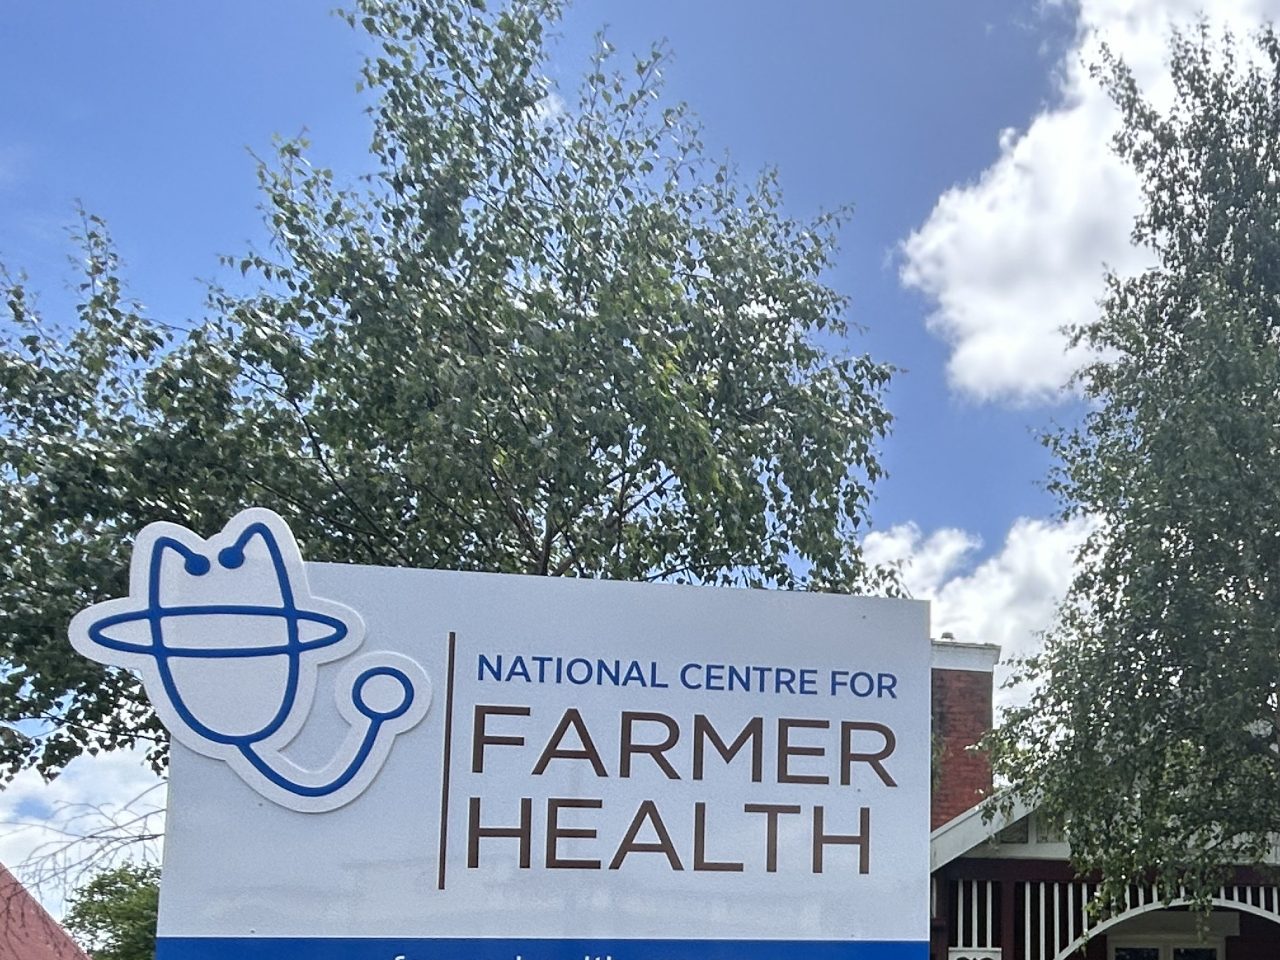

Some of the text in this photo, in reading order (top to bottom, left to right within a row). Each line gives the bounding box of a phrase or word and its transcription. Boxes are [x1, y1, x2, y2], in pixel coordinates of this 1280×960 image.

[477, 654, 898, 699] NATIONAL CENTRE FOR
[472, 704, 898, 788] FARMER
[467, 797, 870, 875] HEALTH
